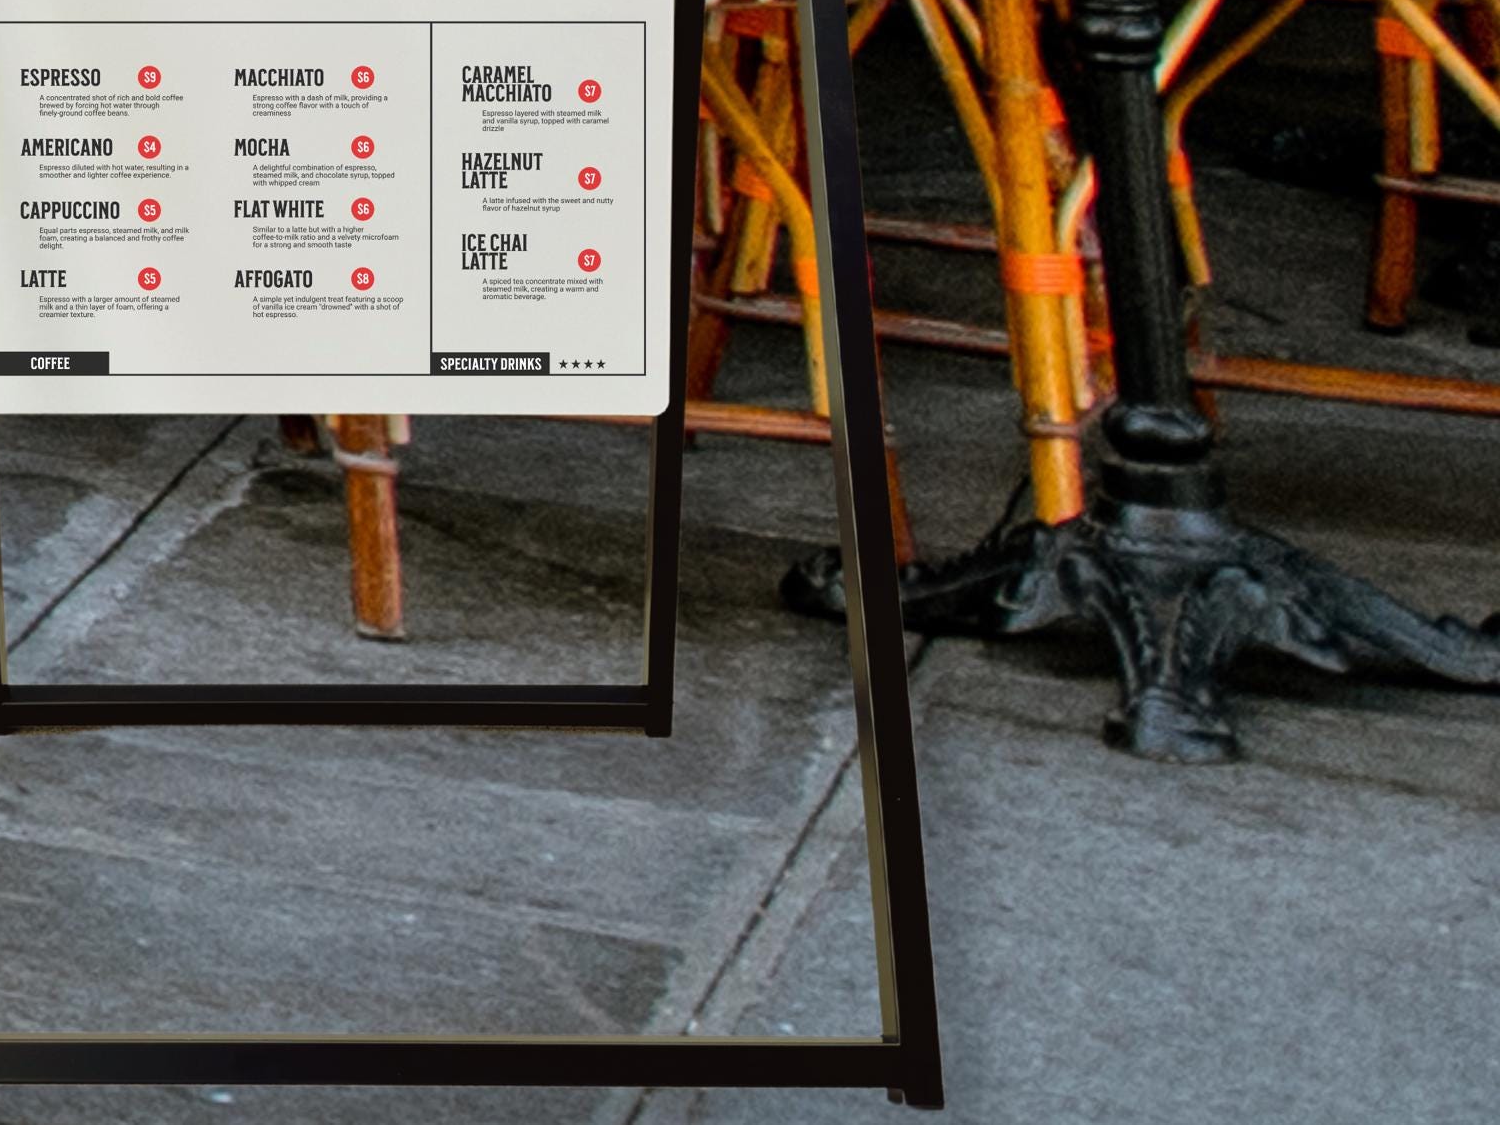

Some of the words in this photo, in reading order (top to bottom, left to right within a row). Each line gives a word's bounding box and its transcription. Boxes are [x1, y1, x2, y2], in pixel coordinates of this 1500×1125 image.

[21, 69, 100, 86] ESPRESSO
[144, 72, 156, 83] $9
[234, 69, 324, 87] MACCHIATO
[358, 72, 369, 83] $6
[462, 66, 534, 83] CARAMEL
[462, 84, 551, 102] MACCHIATO
[585, 85, 596, 97] $7
[21, 138, 112, 156] AMERICANO
[144, 141, 156, 152] $4
[234, 138, 290, 156] MOCHA
[358, 141, 369, 152] $6
[462, 153, 543, 170] HAZELNUT
[462, 171, 508, 189] LATTE
[585, 173, 595, 184] $7
[20, 201, 120, 219] CAPPUCCINO
[144, 204, 156, 216] $5
[234, 200, 270, 217] FLAT
[273, 200, 324, 217] WHITE
[358, 203, 369, 215] $6
[462, 234, 486, 251] ICE
[490, 234, 527, 251] CHAI
[462, 252, 508, 270] LATTE
[584, 254, 595, 266] $7
[21, 270, 66, 287] LATTE
[144, 273, 156, 284] $5
[234, 270, 312, 288] AFFOGATO
[357, 273, 369, 284] $8
[31, 357, 70, 369] COFFEE
[441, 358, 498, 370] SPECIALTY
[501, 358, 542, 370] DRINKS
